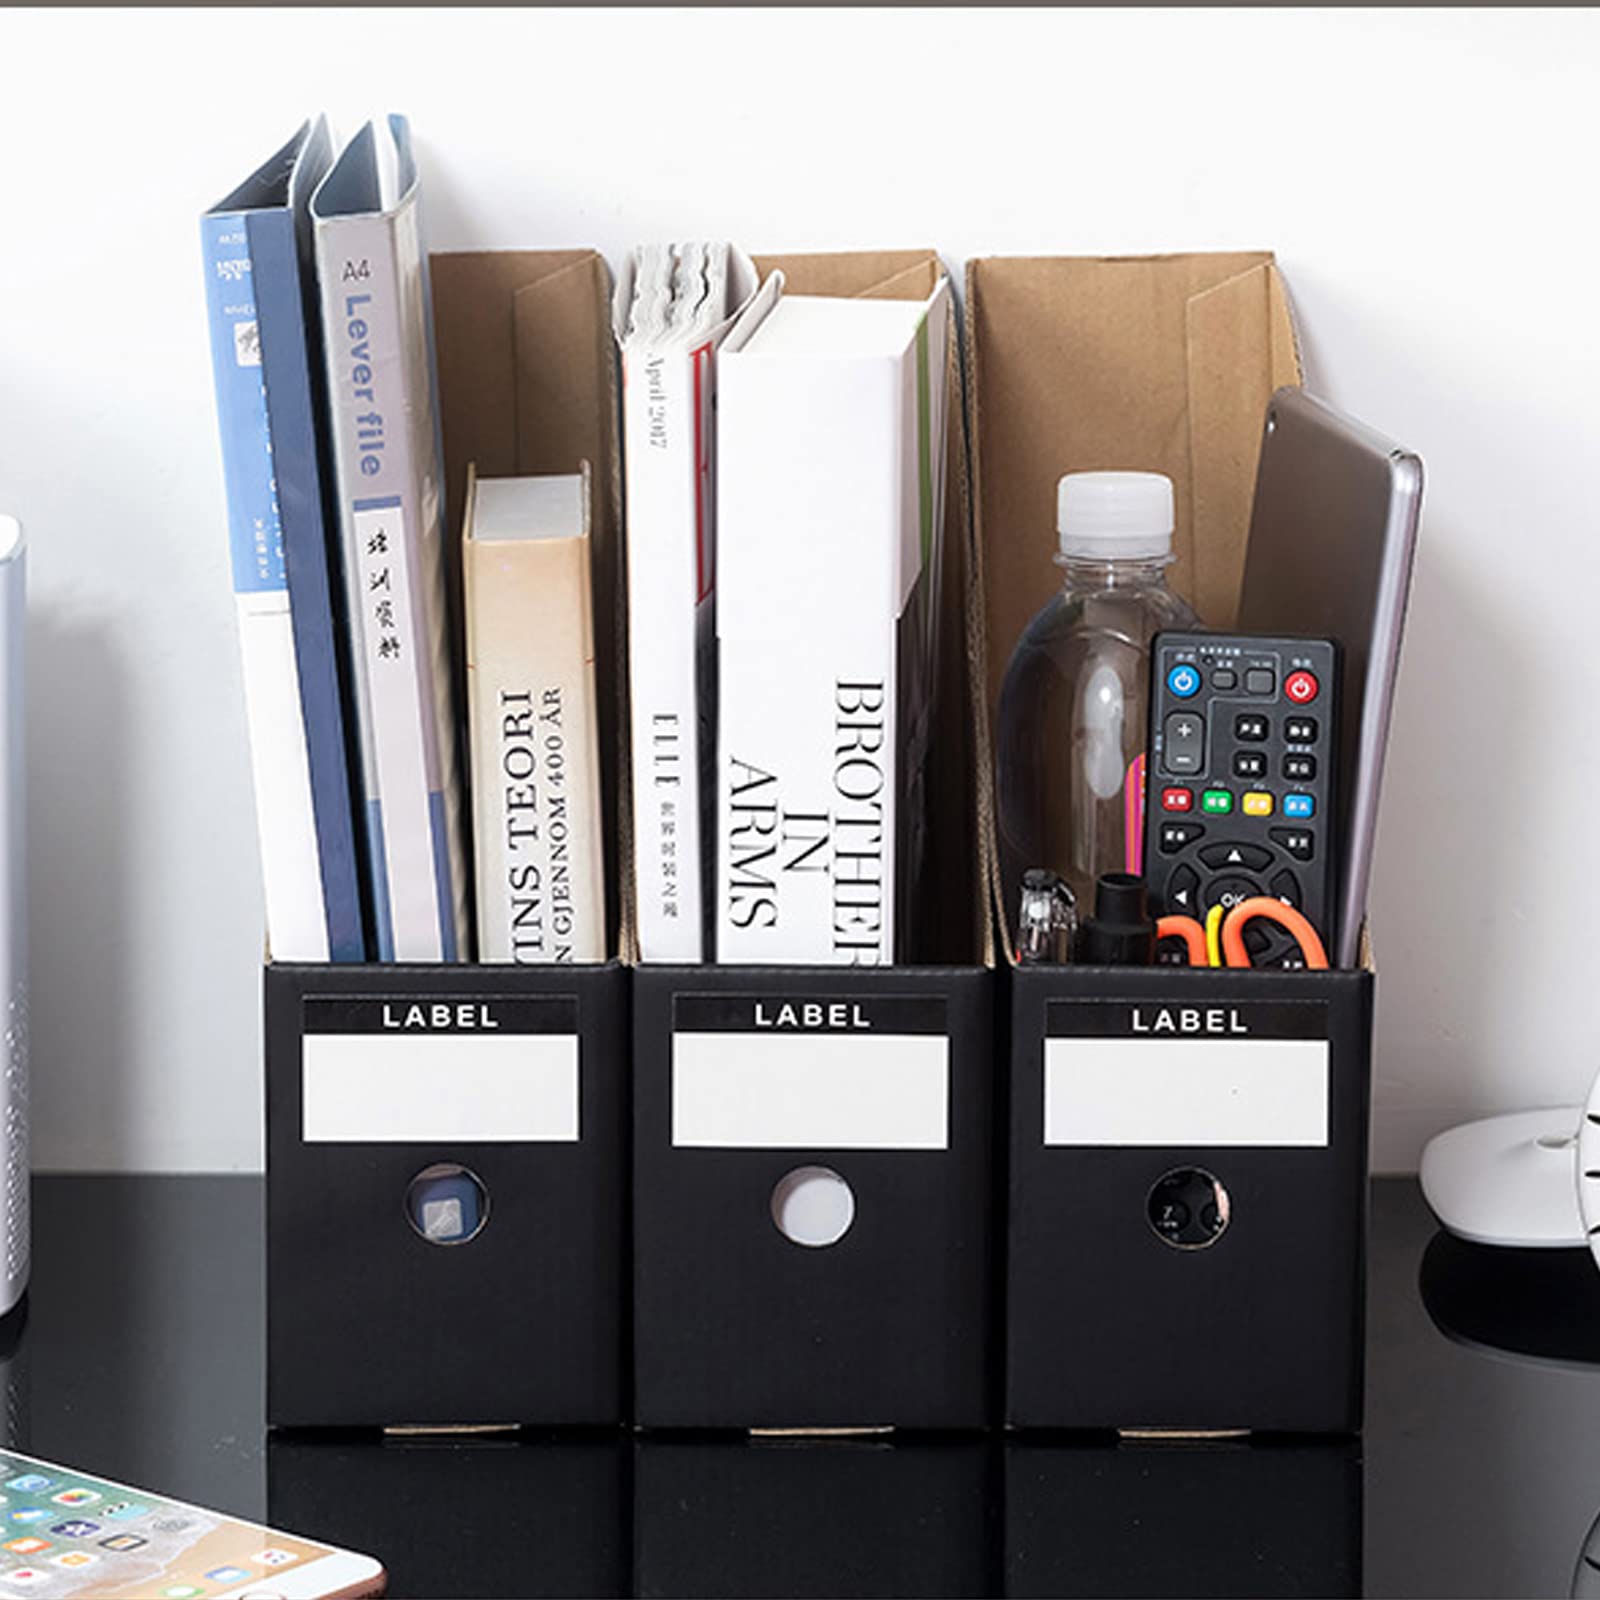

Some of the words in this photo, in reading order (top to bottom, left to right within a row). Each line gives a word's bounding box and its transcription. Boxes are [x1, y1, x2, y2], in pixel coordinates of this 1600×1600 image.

[342, 259, 371, 282] A4
[345, 294, 374, 403] Lever
[644, 352, 667, 402] April
[356, 411, 384, 477] file
[539, 687, 562, 727] ÅR
[500, 690, 540, 850] TEORI
[544, 735, 564, 787] 400
[547, 797, 575, 935] GJENNOM
[729, 755, 778, 929] ARMS
[782, 811, 829, 873] IN
[555, 943, 573, 963] N
[383, 1004, 498, 1028] LABEL
[755, 1003, 870, 1028] LABEL
[1132, 1008, 1248, 1033] LABEL
